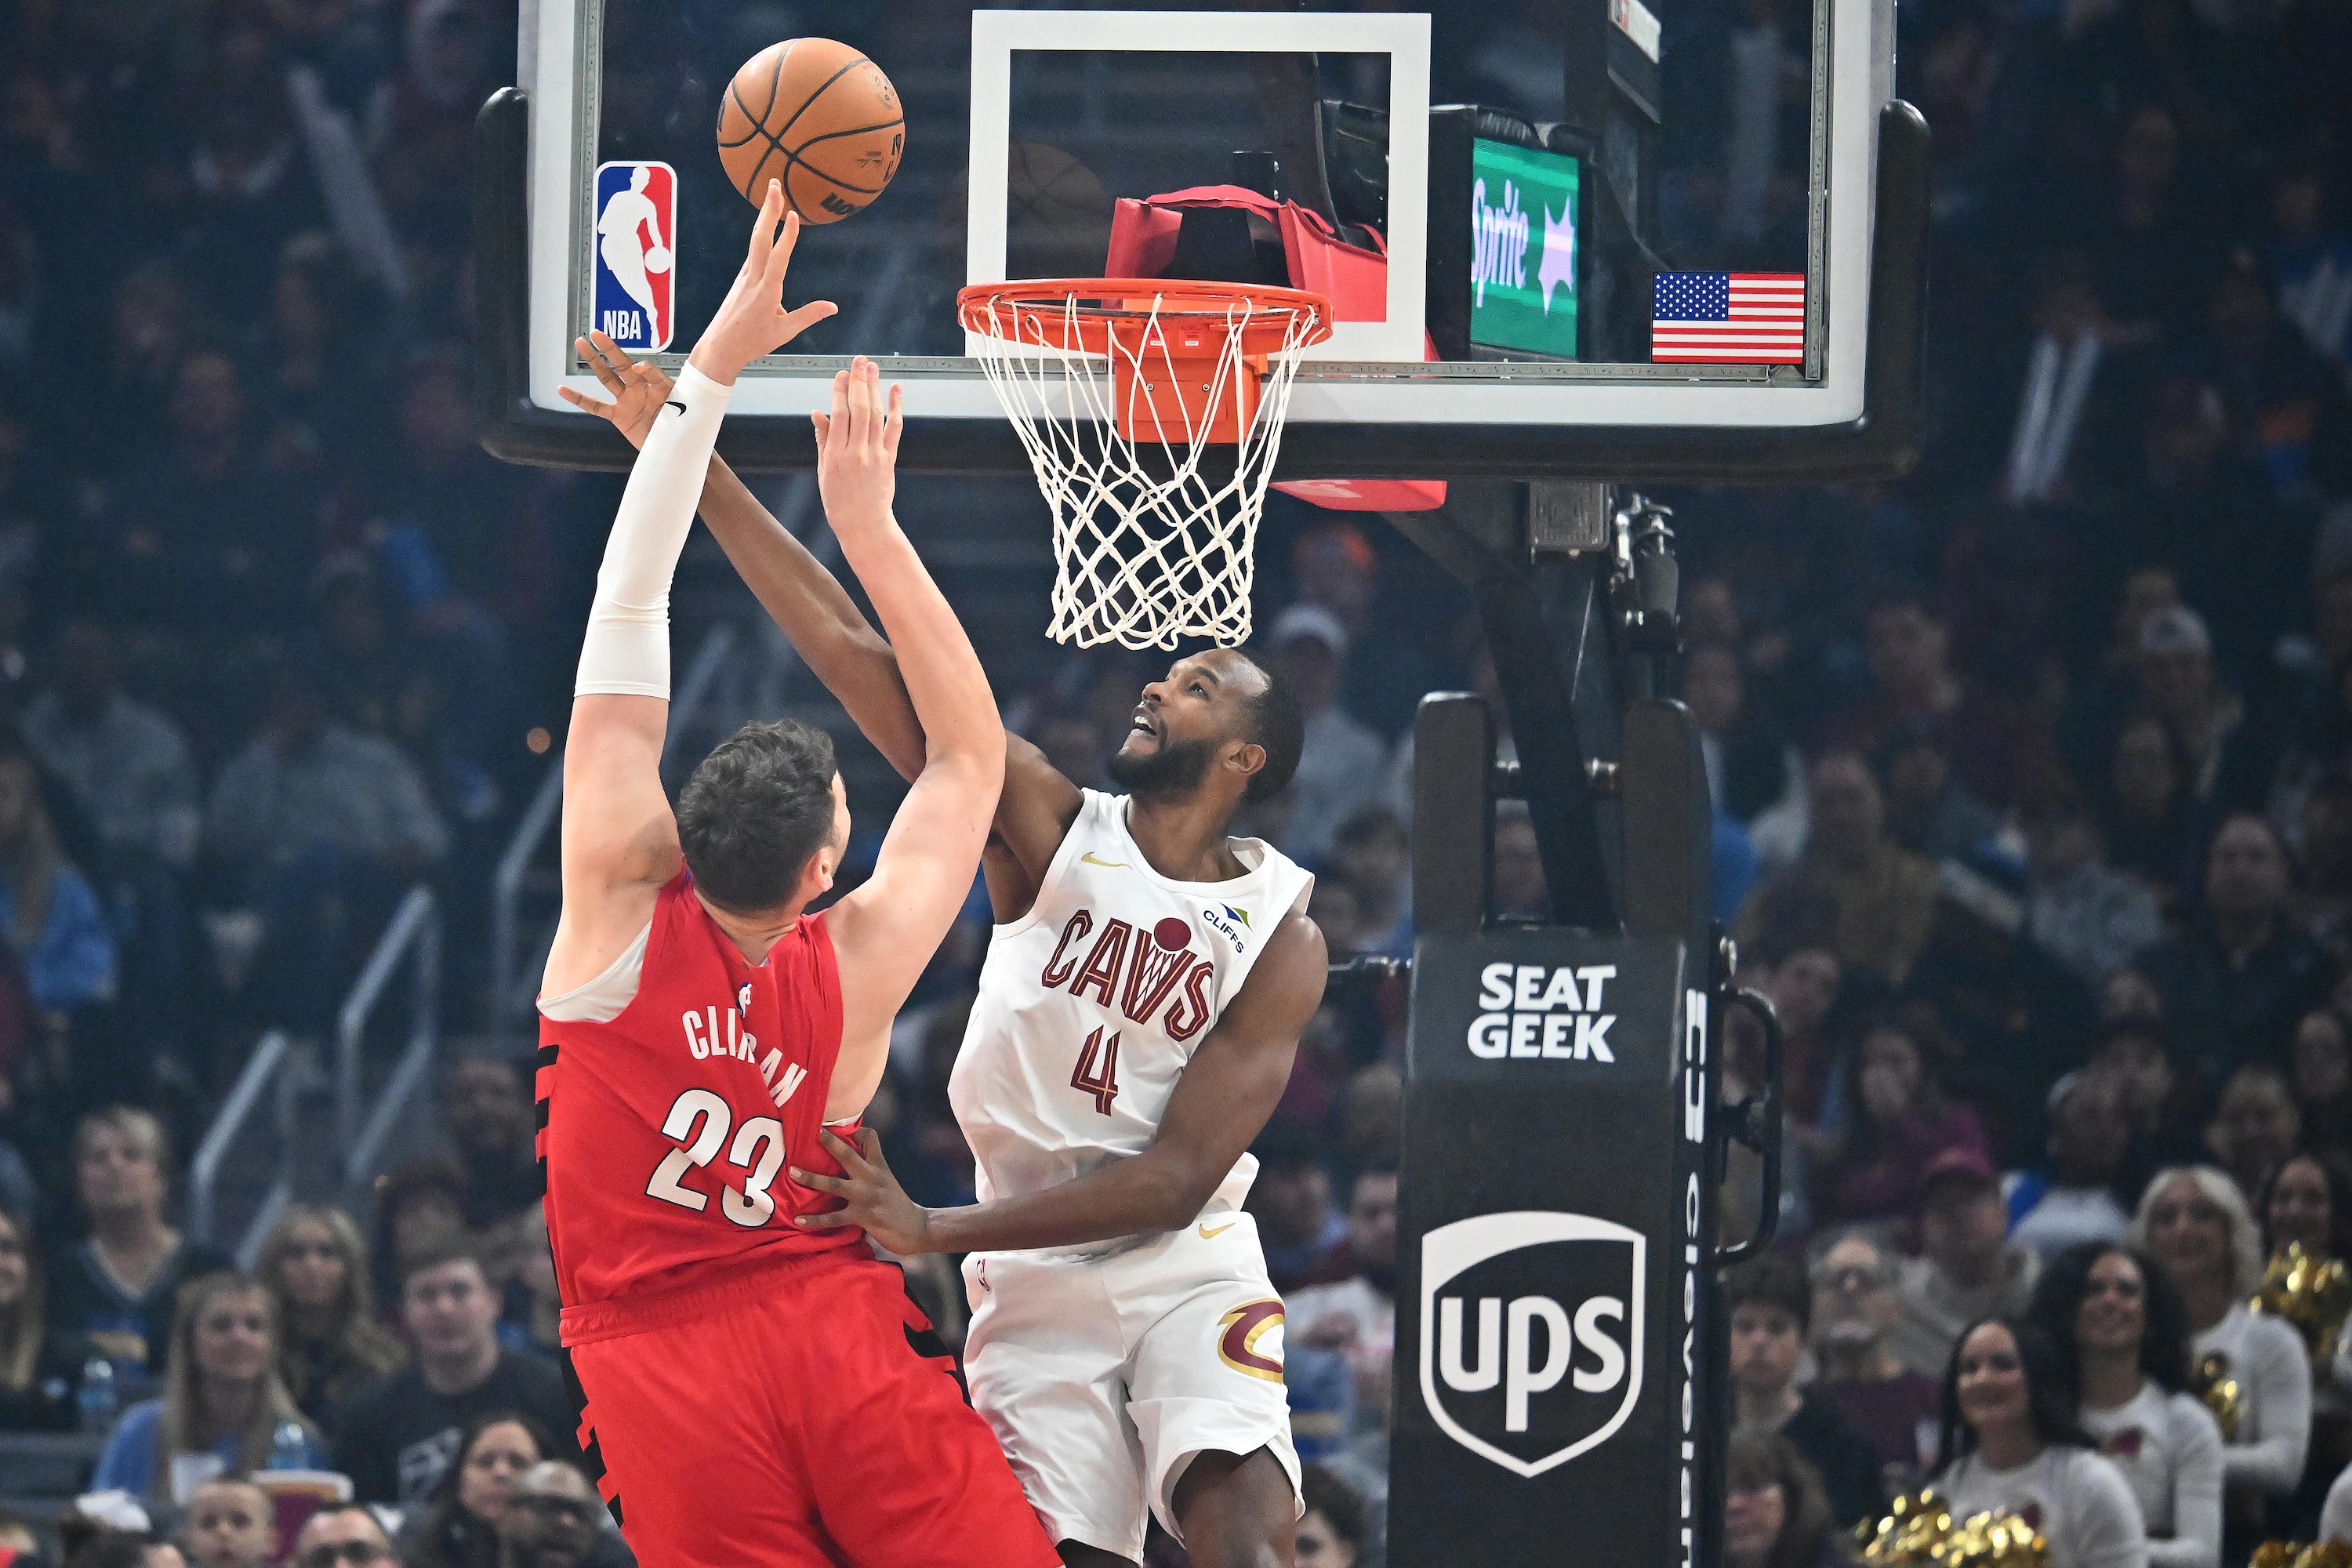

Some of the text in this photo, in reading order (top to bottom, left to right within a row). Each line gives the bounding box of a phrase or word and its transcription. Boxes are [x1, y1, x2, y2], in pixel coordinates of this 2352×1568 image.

[1471, 177, 1529, 307] Sprite
[603, 310, 641, 339] NBA
[1041, 909, 1214, 1042] CAVS
[1203, 909, 1244, 953] CLIFFS
[1479, 963, 1617, 1011] SEAT
[1070, 1024, 1122, 1116] 4
[1467, 1014, 1617, 1063] GEEK
[645, 1088, 786, 1227] 23
[1439, 1295, 1625, 1432] ups
